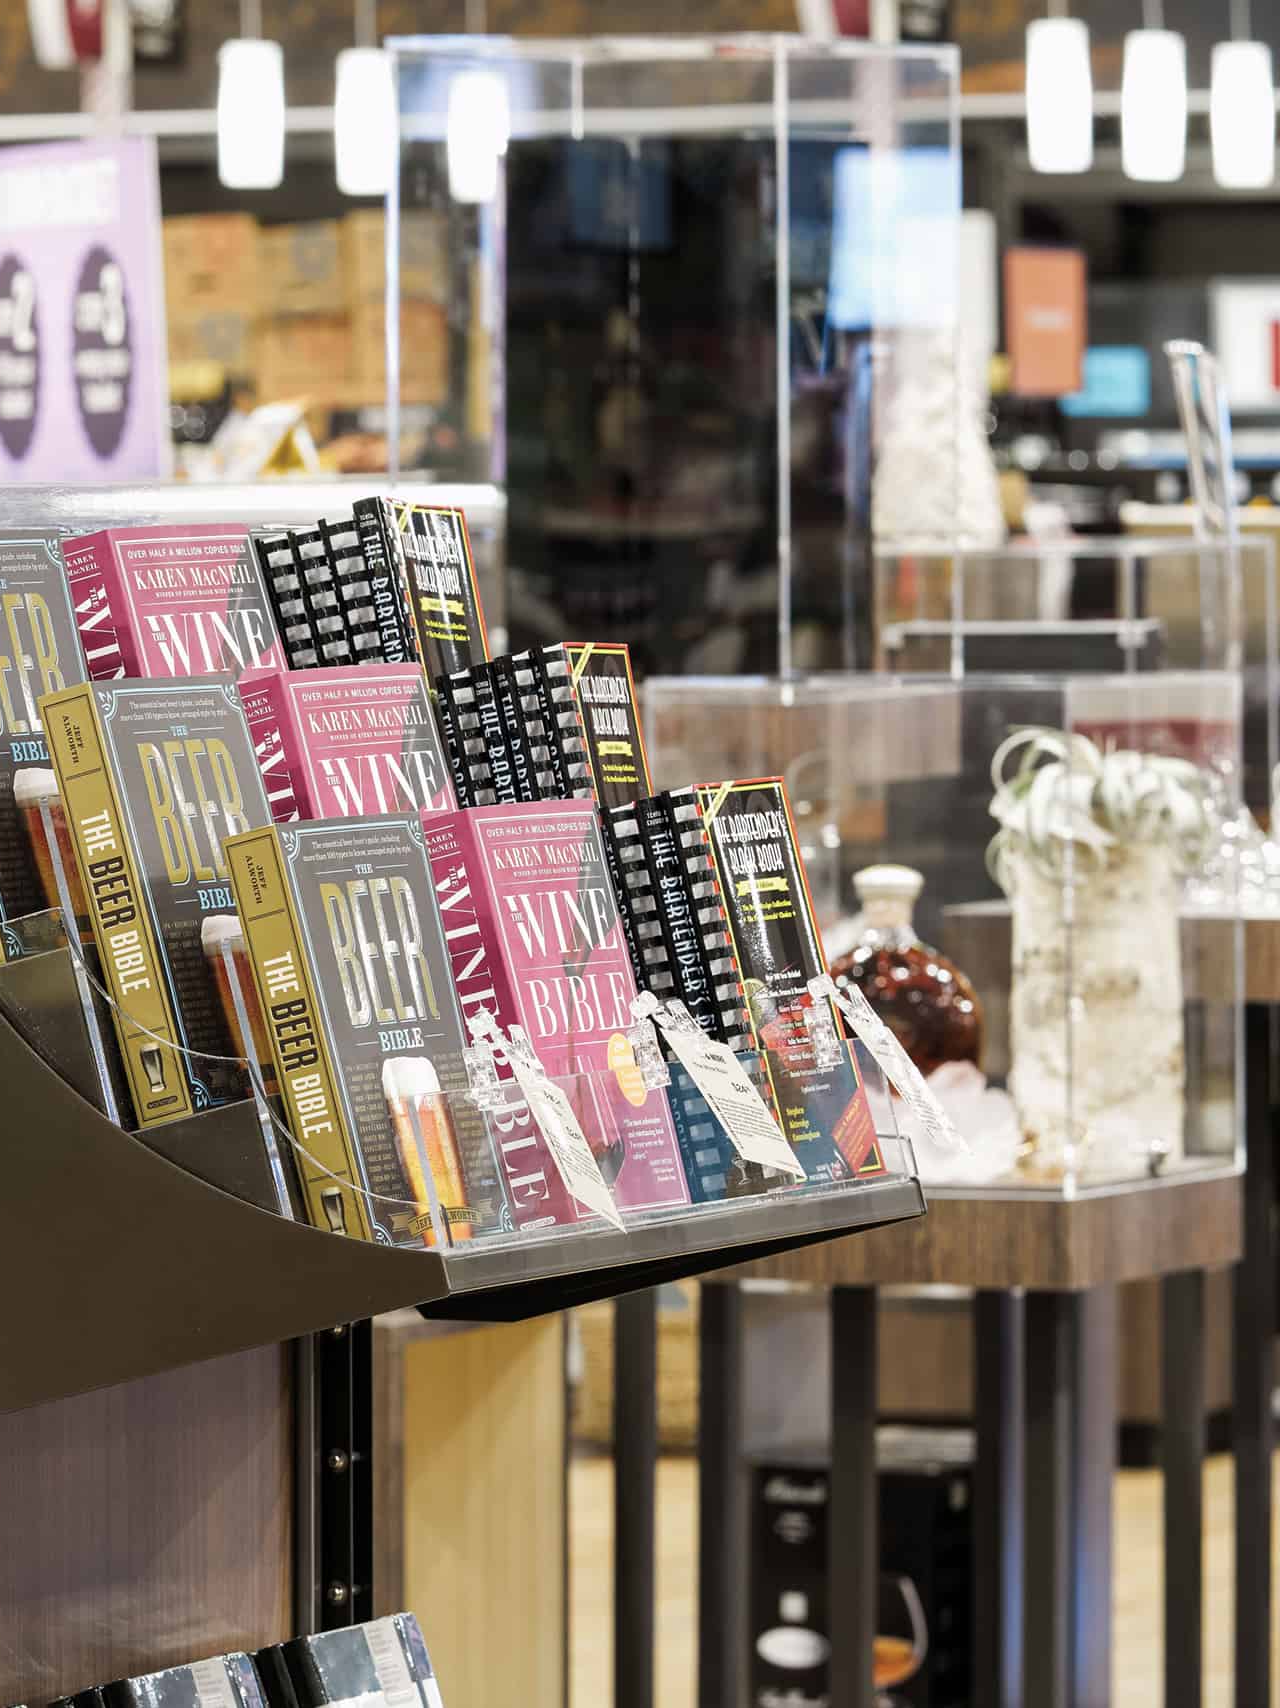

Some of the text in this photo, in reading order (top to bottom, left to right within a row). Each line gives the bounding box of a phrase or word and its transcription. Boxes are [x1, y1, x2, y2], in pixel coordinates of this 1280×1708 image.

[127, 549, 145, 560] OVER
[149, 548, 166, 558] HALF
[175, 545, 202, 557] MILLION
[133, 567, 187, 591] KAREN
[362, 531, 405, 664] THE BARTEND
[144, 608, 277, 678] THE WINE
[301, 691, 322, 702] OVER
[324, 690, 341, 700] HALF
[351, 687, 378, 698] MILLION
[379, 686, 402, 696] COPIES
[170, 725, 189, 737] THE
[307, 709, 362, 735] KAREN
[480, 700, 502, 739] THE
[9, 741, 48, 763] BIBL
[62, 715, 80, 764] ALWORTH
[320, 750, 449, 817] THE WINE
[136, 738, 251, 887] BEER
[530, 823, 556, 834] MILLION
[557, 822, 578, 832] COPIES
[493, 846, 543, 870] KAREN
[649, 829, 680, 869] THE
[756, 842, 786, 873] BOOK
[244, 855, 263, 905] ALWORTH
[355, 863, 374, 875] THE
[80, 808, 151, 996] THE BEER BIBLE
[197, 887, 236, 910] BIBL
[511, 911, 525, 922] THE
[503, 887, 619, 960] WINE
[659, 874, 711, 1006] BARTENDER'S
[319, 876, 441, 1028] BEER
[524, 971, 636, 1038] BIBLE
[263, 950, 333, 1139] THE BEER BIBLE
[377, 1027, 424, 1052] BIBLE
